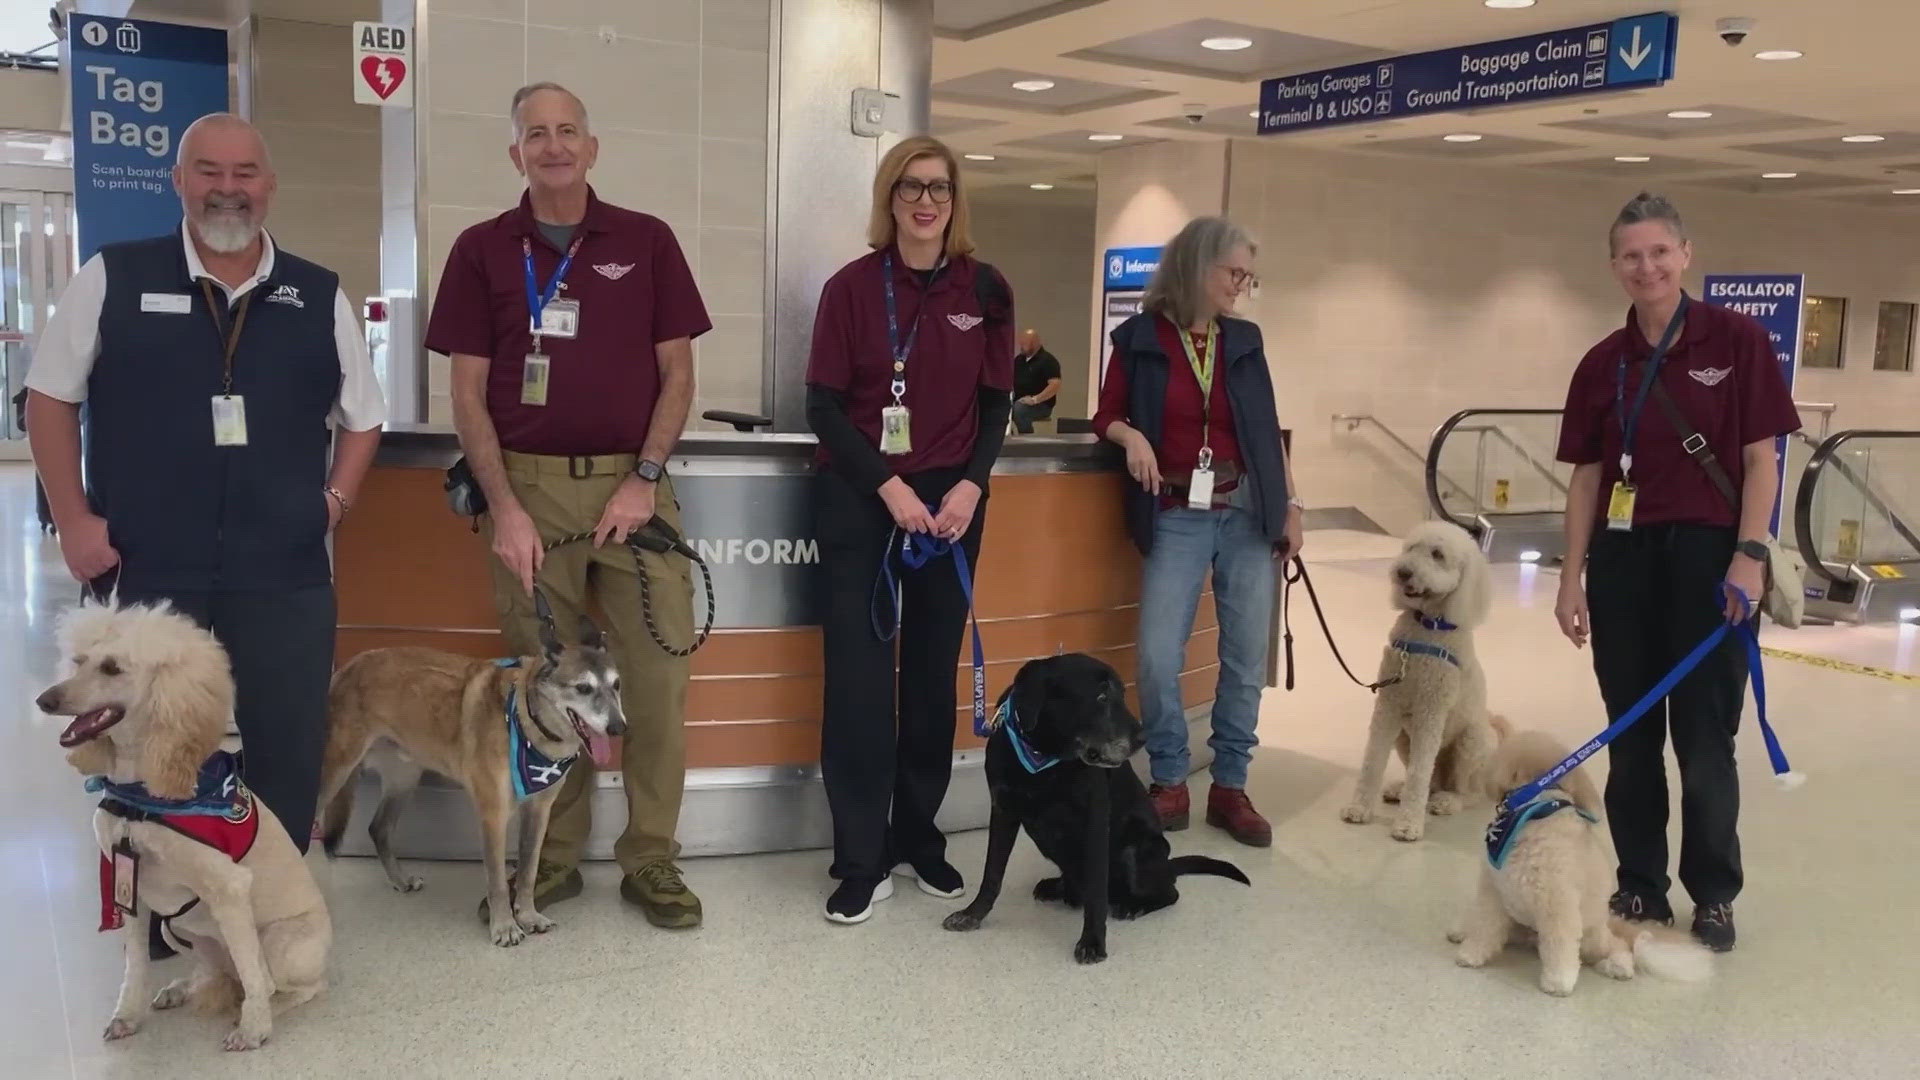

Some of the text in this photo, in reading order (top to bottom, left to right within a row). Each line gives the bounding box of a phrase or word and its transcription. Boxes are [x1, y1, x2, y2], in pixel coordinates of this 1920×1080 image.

[360, 26, 406, 50] AED
[1461, 39, 1582, 76] Baggage Claim
[86, 65, 163, 113] Tag
[1278, 78, 1319, 100] Parking
[1321, 73, 1371, 94] Garages
[1406, 70, 1578, 108] Ground Transportation
[1263, 96, 1373, 128] Terminal B & USO
[90, 111, 170, 157] Bag
[92, 163, 124, 175] Scan
[92, 178, 166, 194] to print tag.
[1710, 282, 1796, 297] ESCALATOR
